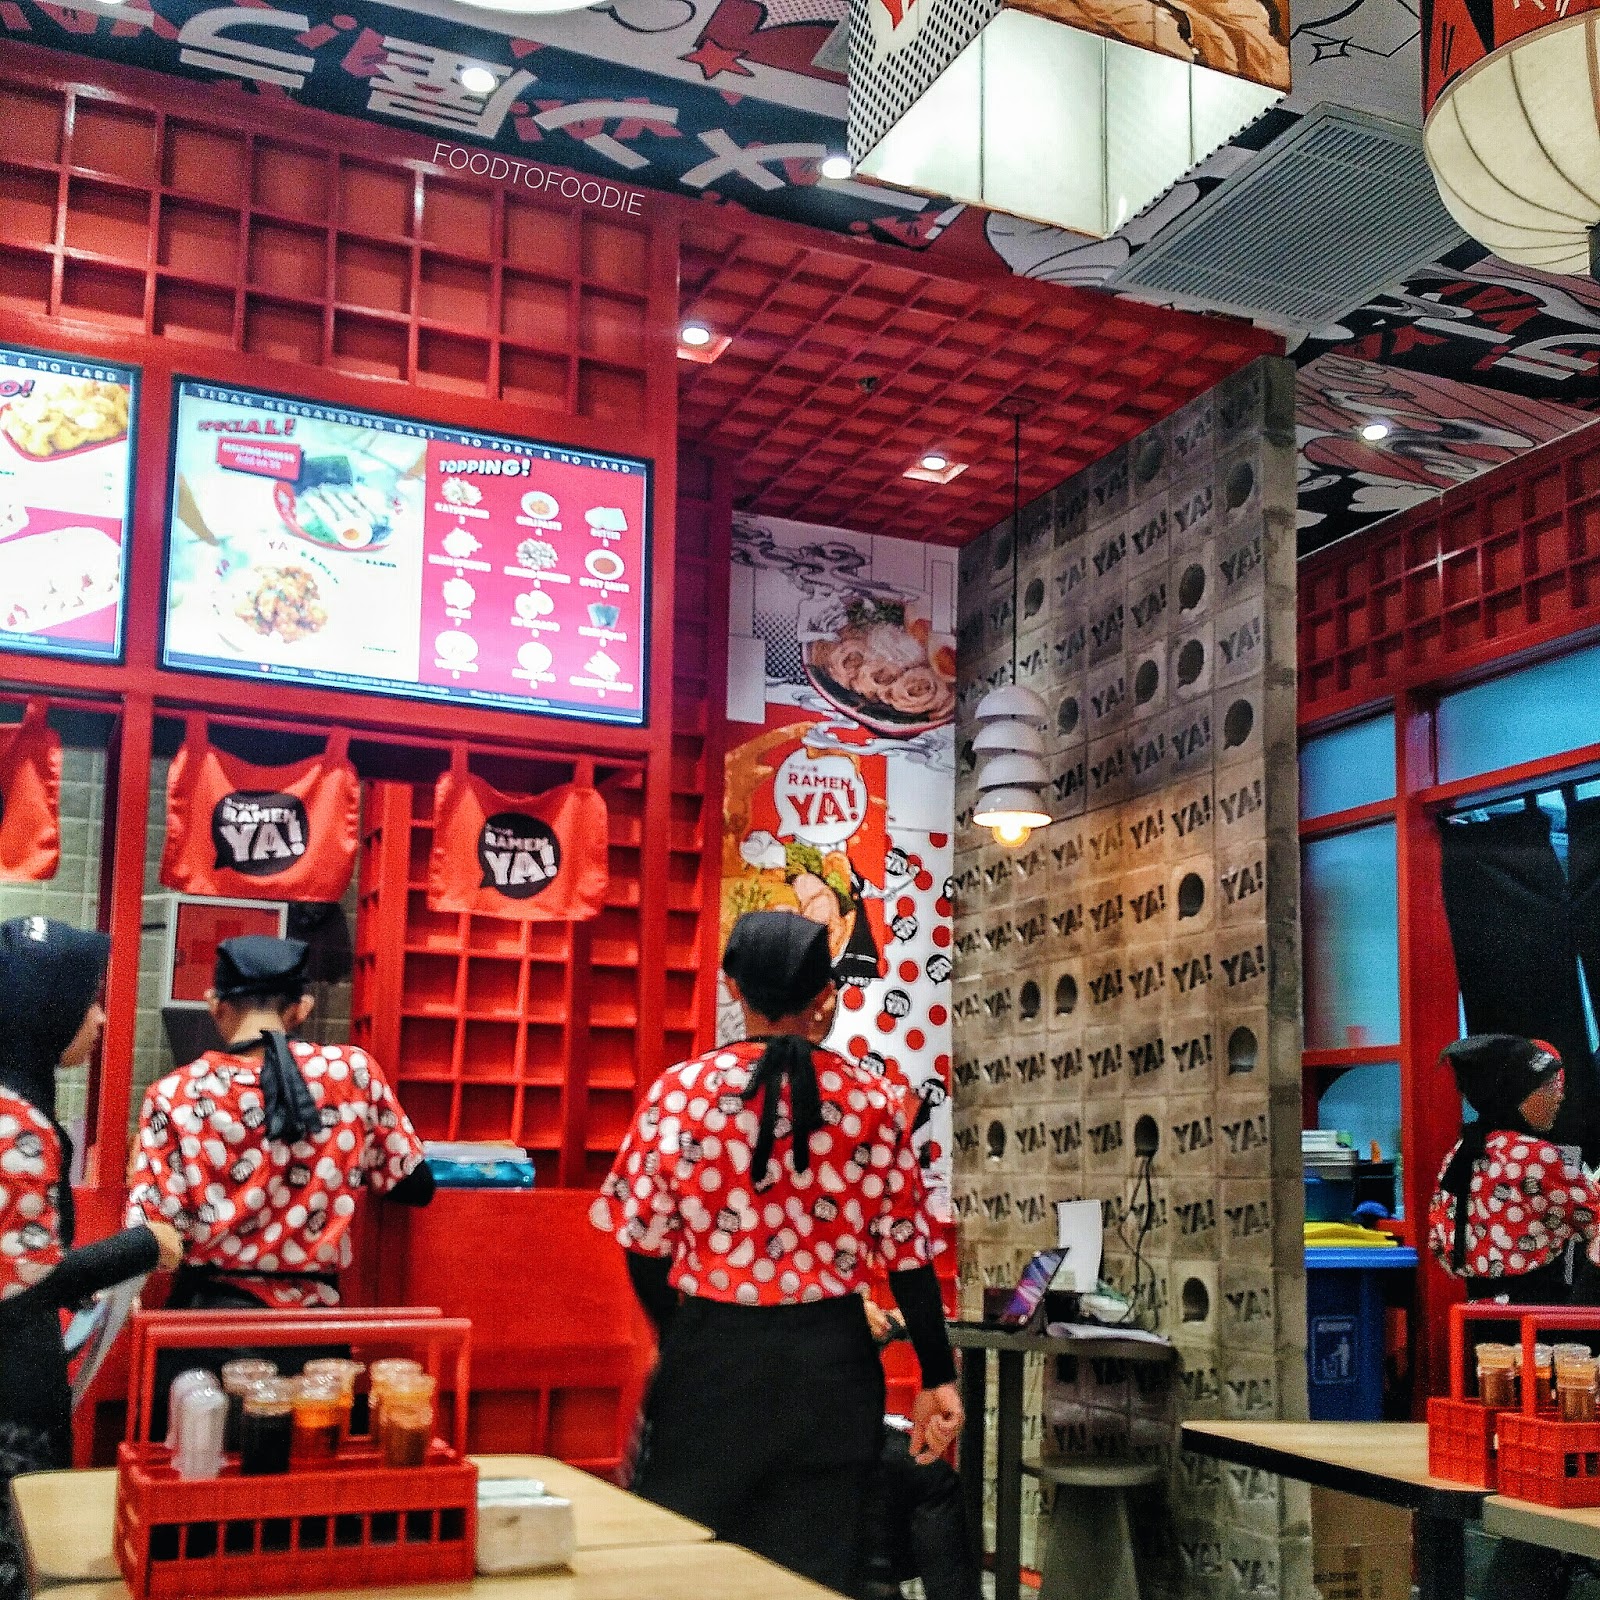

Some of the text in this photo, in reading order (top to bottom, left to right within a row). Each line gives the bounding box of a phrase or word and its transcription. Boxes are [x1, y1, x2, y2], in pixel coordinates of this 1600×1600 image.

[37, 360, 61, 372] NO
[71, 366, 117, 382] LARD
[197, 387, 253, 406] TIDAK
[263, 399, 386, 430] MENGANDUNG
[394, 423, 435, 440] BABI
[460, 436, 482, 448] NO
[491, 441, 534, 457] PORK
[560, 453, 581, 465] NO
[590, 459, 632, 474] LARD
[438, 458, 531, 478] TOPPING!
[1057, 556, 1086, 594] YA!
[1093, 534, 1126, 575] YA!
[1133, 513, 1168, 554] YA!
[1174, 485, 1212, 531] YA!
[1055, 628, 1084, 664] YA!
[1091, 605, 1125, 646] YA!
[1131, 583, 1165, 627] YA!
[1220, 539, 1261, 585] YA!
[1091, 618, 1260, 718] YA! YA!
[1053, 716, 1210, 802] YA! YA! YA! YA!
[788, 772, 852, 791] RAMEN
[222, 805, 297, 824] RAMEN
[786, 788, 860, 826] YA!
[218, 818, 306, 863] YA!
[484, 831, 550, 852] RAMEN
[986, 857, 1012, 886] YA!
[1016, 844, 1045, 880] YA!
[1053, 837, 1083, 870] YA!
[1090, 823, 1122, 861] YA!
[1130, 809, 1164, 849] YA!
[1172, 795, 1211, 837] YA!
[1220, 780, 1261, 825] YA!
[484, 844, 558, 885] YA!
[954, 929, 980, 957] YA!
[986, 920, 1012, 952] YA!
[1017, 913, 1045, 946] YA!
[1053, 904, 1082, 938] YA!
[1089, 895, 1123, 933] YA!
[1130, 885, 1165, 924] YA!
[1221, 861, 1263, 905] YA!
[953, 993, 980, 1026] YA!
[985, 988, 1011, 1019] YA!
[1090, 969, 1122, 1005] YA!
[1129, 962, 1164, 1000] YA!
[1173, 955, 1212, 993] YA!
[1221, 946, 1265, 988] YA!
[954, 1035, 1212, 1087] YA! YA! YA! YA! YA! YA! YA!
[954, 1116, 1267, 1154] YA! YA! YA! YA! YA! YA!
[953, 1191, 979, 1221] YA!
[983, 1194, 1011, 1222] YA!
[1016, 1195, 1046, 1224] YA!
[1174, 1200, 1216, 1234] YA!
[1225, 1201, 1271, 1236] YA!
[1226, 1287, 1271, 1320] YA!
[1181, 1368, 1218, 1401] YA!
[1227, 1378, 1272, 1410] YA!
[1232, 1559, 1276, 1590] YA!
